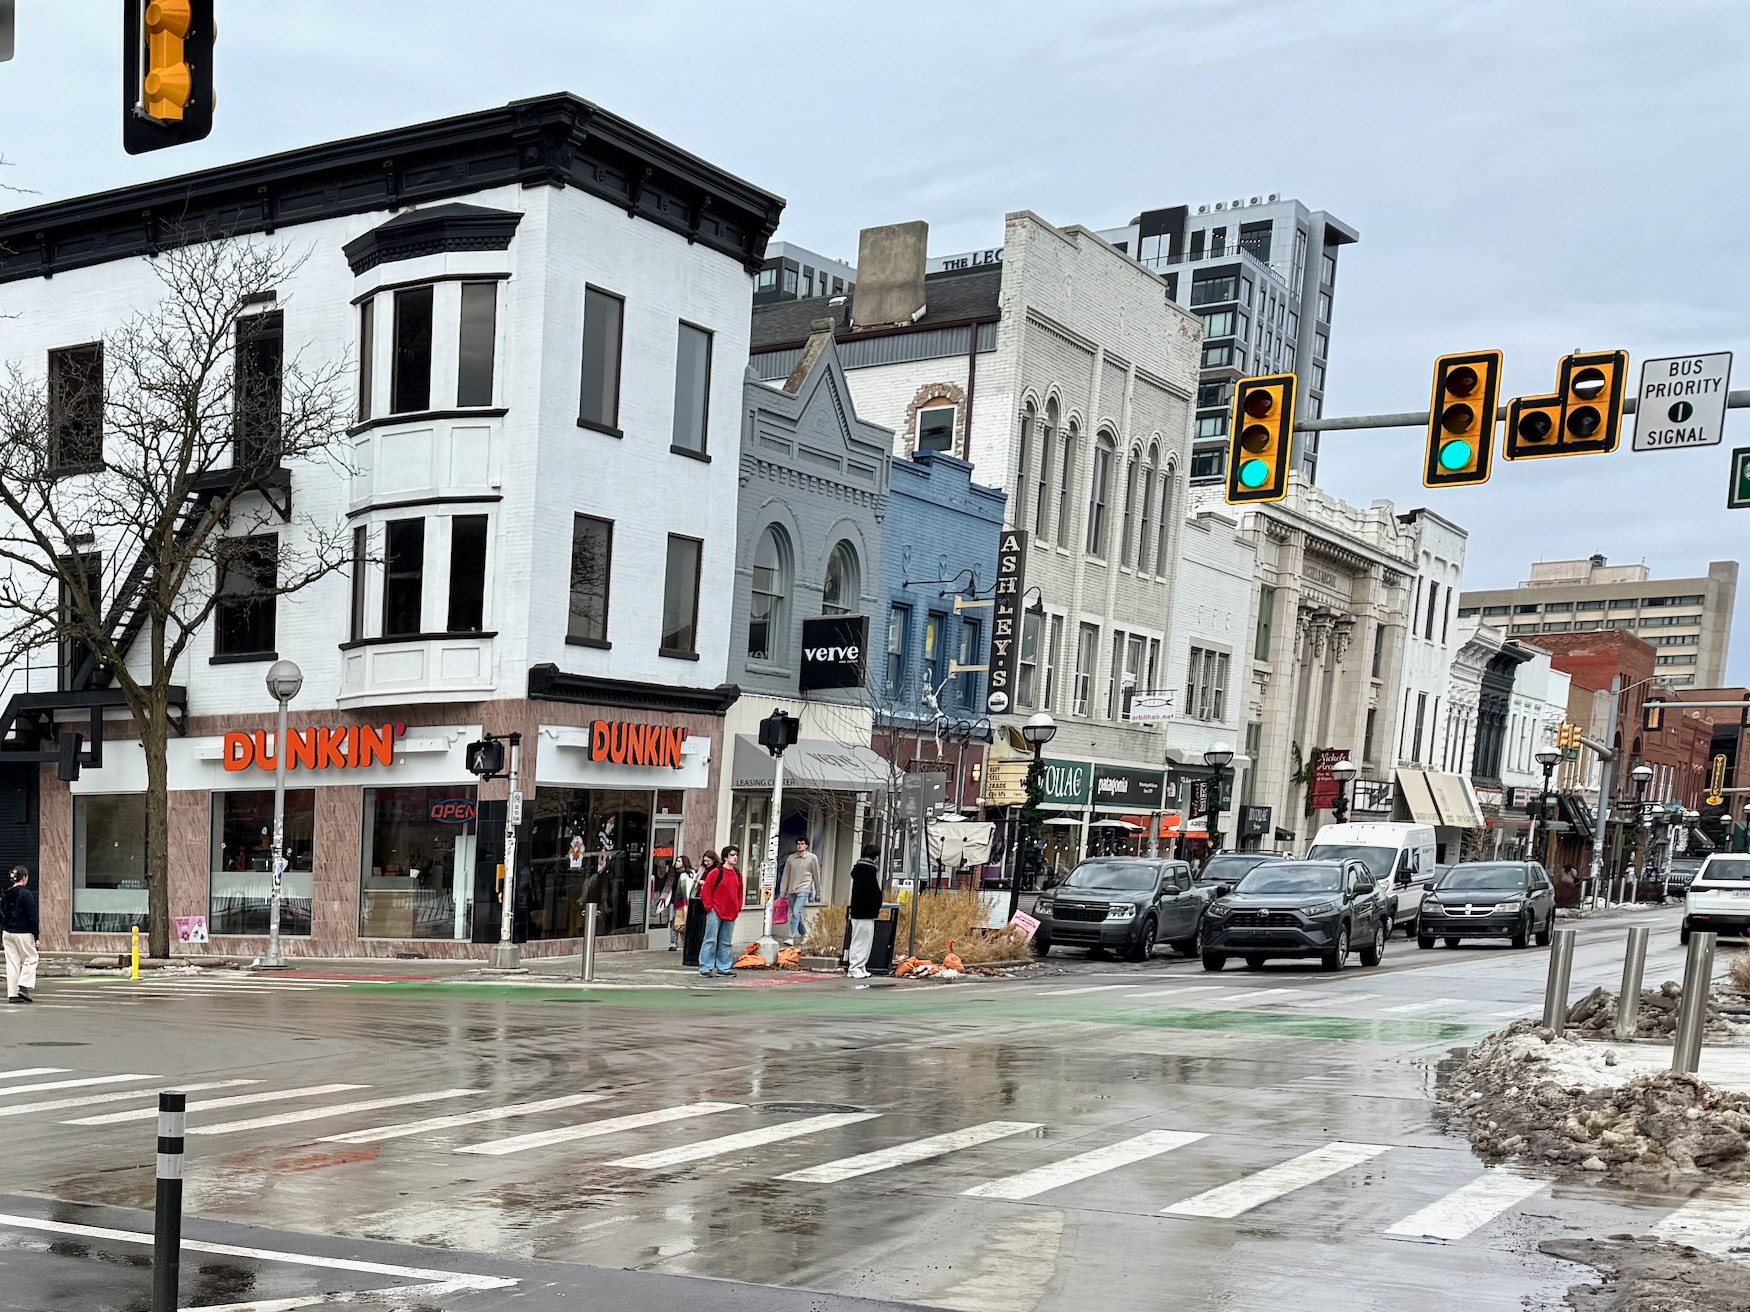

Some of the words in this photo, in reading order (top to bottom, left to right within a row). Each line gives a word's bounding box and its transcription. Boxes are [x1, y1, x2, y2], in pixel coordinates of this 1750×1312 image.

[1669, 360, 1703, 377] BUS
[1645, 377, 1722, 399] PRIORITY
[1647, 427, 1707, 446] SIGNAL
[804, 646, 859, 661] verve
[224, 721, 406, 771] DUNKIN'
[588, 720, 689, 768] DUNKIN'
[805, 752, 860, 768] verve
[767, 779, 796, 787] CTER
[1097, 776, 1128, 796] patagonia
[431, 804, 477, 819] OPEN
